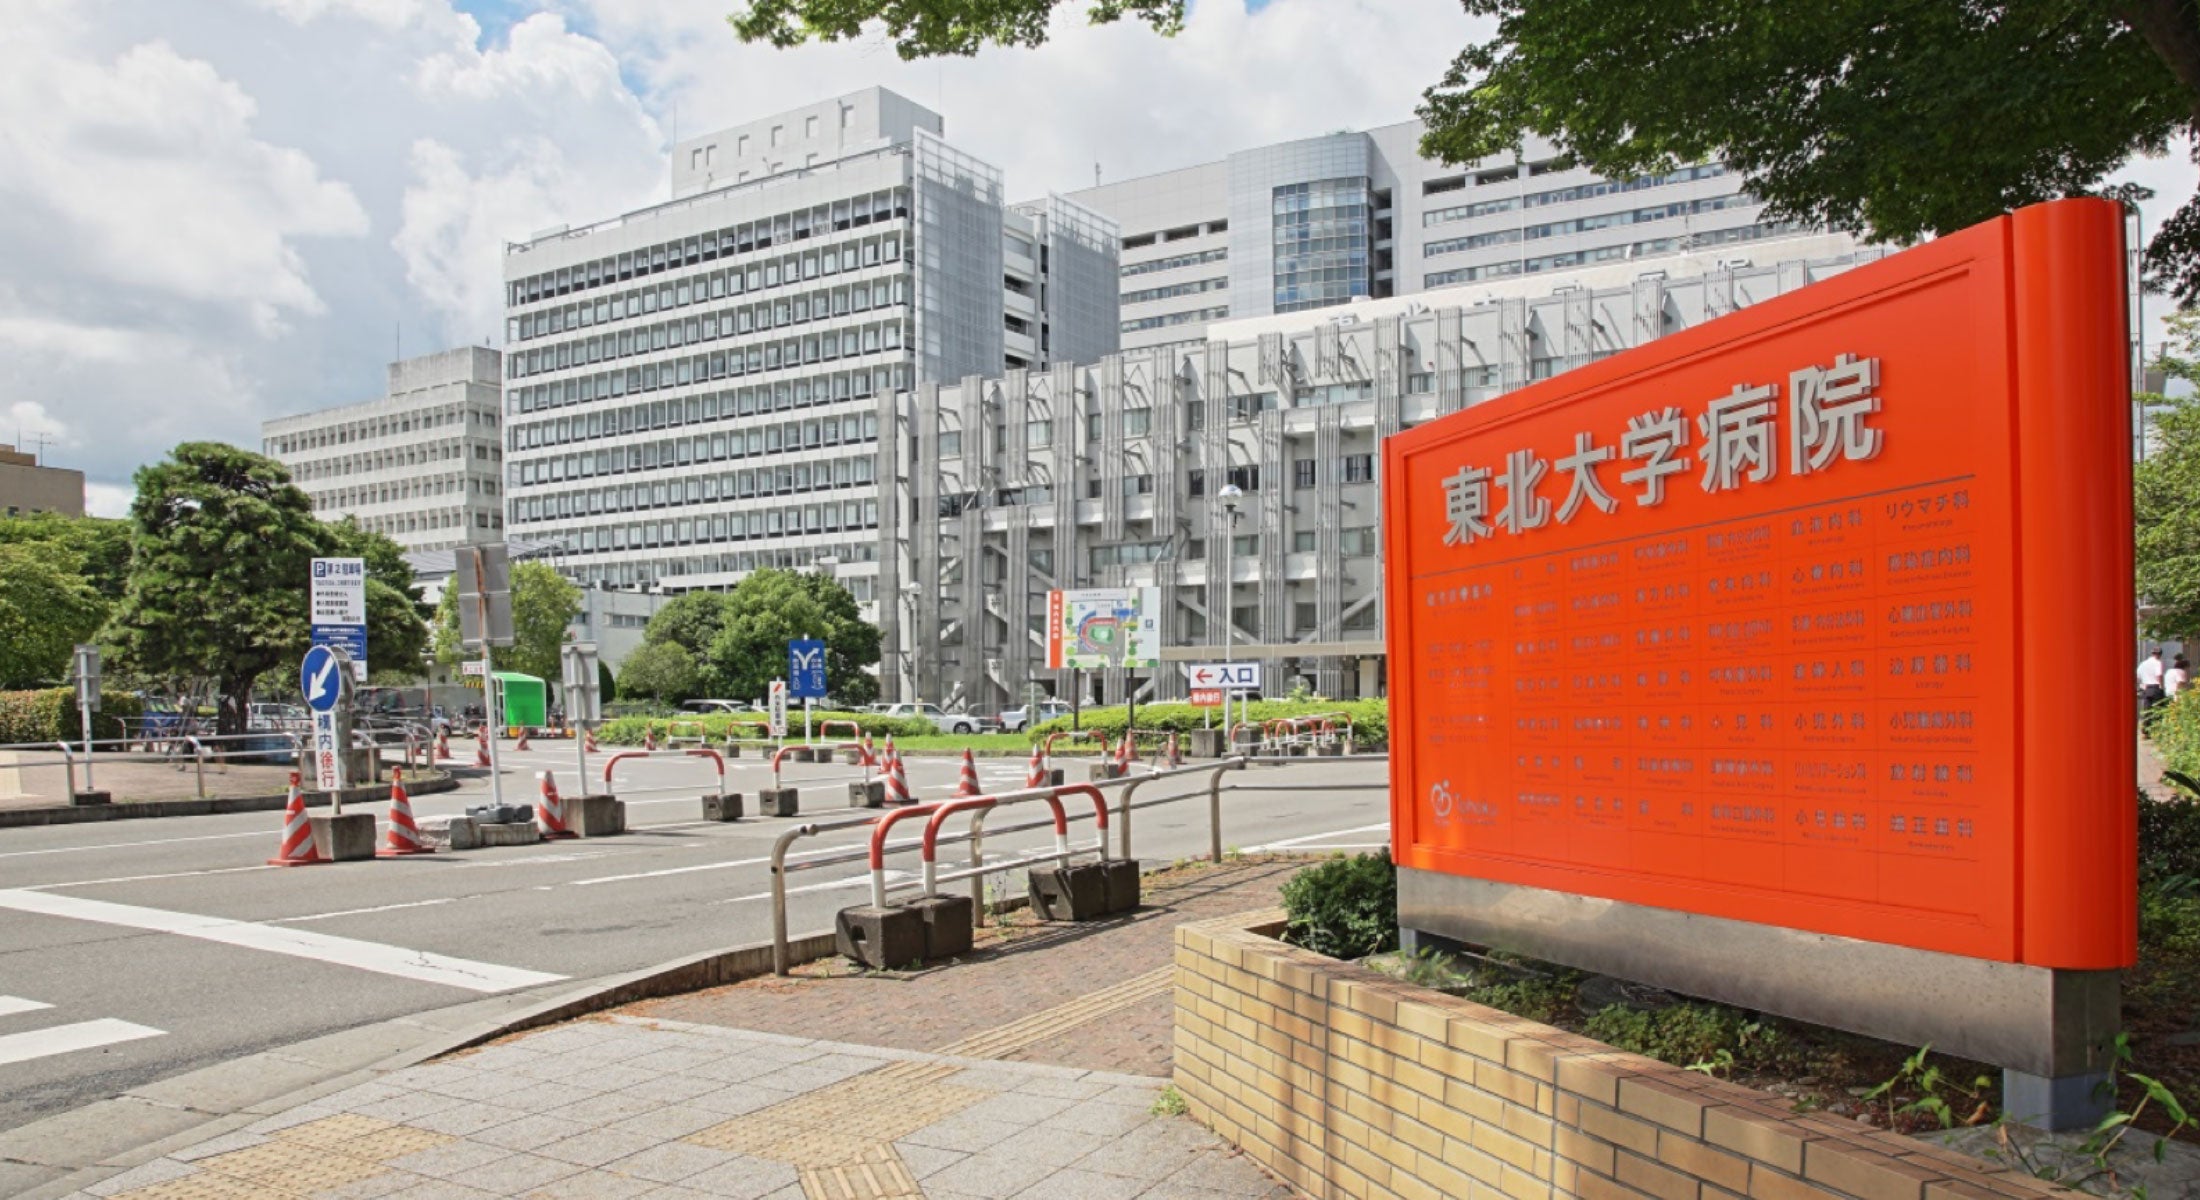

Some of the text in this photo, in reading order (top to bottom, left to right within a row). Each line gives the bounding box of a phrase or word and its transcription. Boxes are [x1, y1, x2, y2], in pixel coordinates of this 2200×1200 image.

[1441, 352, 1882, 546] 東北大学病院
[1885, 489, 1970, 521] リウマチ科
[1790, 508, 1863, 537] 血液内科
[1887, 543, 1971, 572] 感染症内科
[1792, 558, 1864, 583] 心療内科
[1218, 667, 1252, 684] 入口
[1889, 653, 1972, 675] 泌尿器科
[1793, 712, 1866, 731] 小児外科
[1889, 763, 1973, 783] 放射線科
